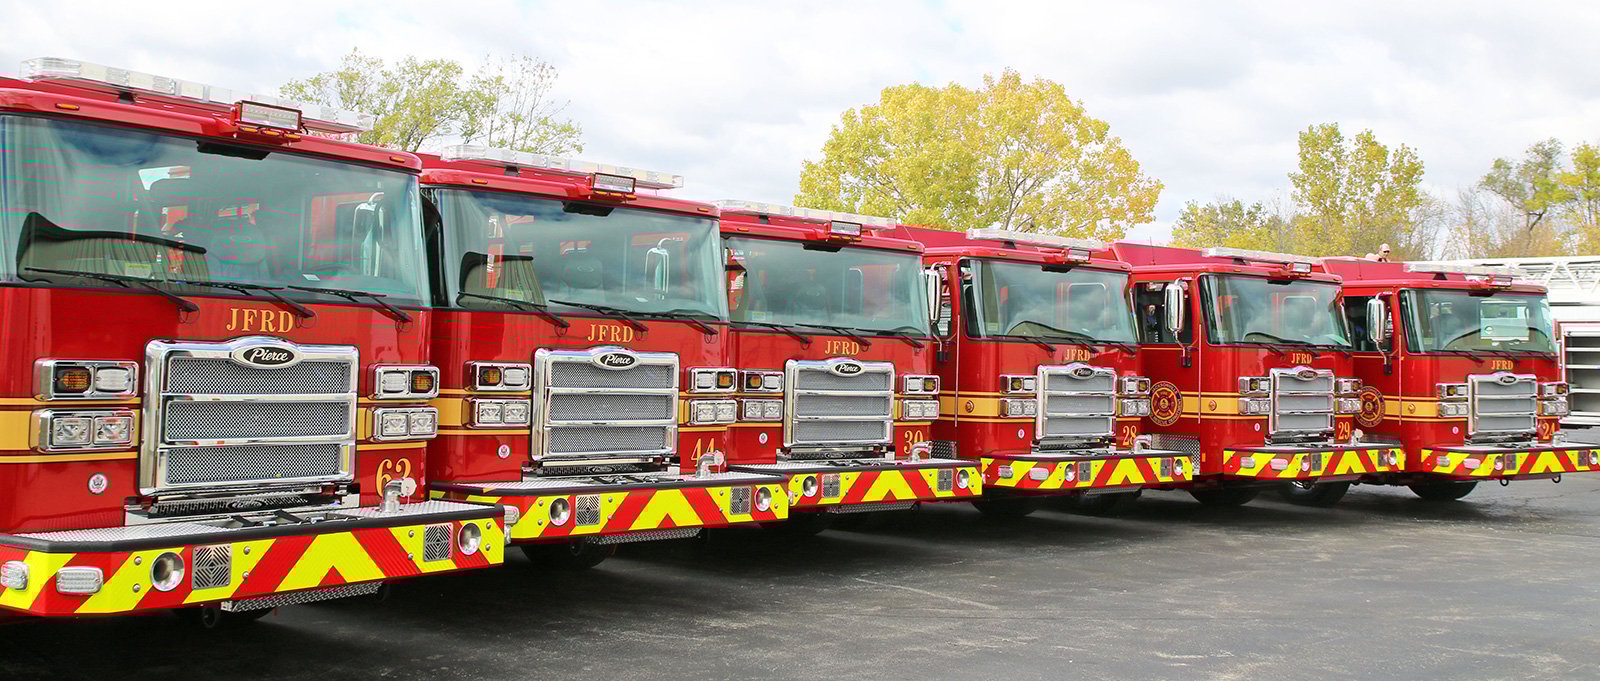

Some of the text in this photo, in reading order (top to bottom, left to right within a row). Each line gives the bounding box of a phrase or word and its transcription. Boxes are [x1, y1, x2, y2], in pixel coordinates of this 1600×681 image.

[226, 308, 294, 333] JFRD
[588, 324, 634, 343] JFRD
[824, 340, 860, 355] JFRD
[1065, 349, 1090, 361] JFRD
[249, 348, 288, 363] Pierce
[604, 354, 632, 365] Pierce
[1291, 353, 1312, 364] JFRD
[1491, 360, 1513, 370] JFRD
[1122, 425, 1137, 446] 28
[1338, 421, 1350, 440] 29
